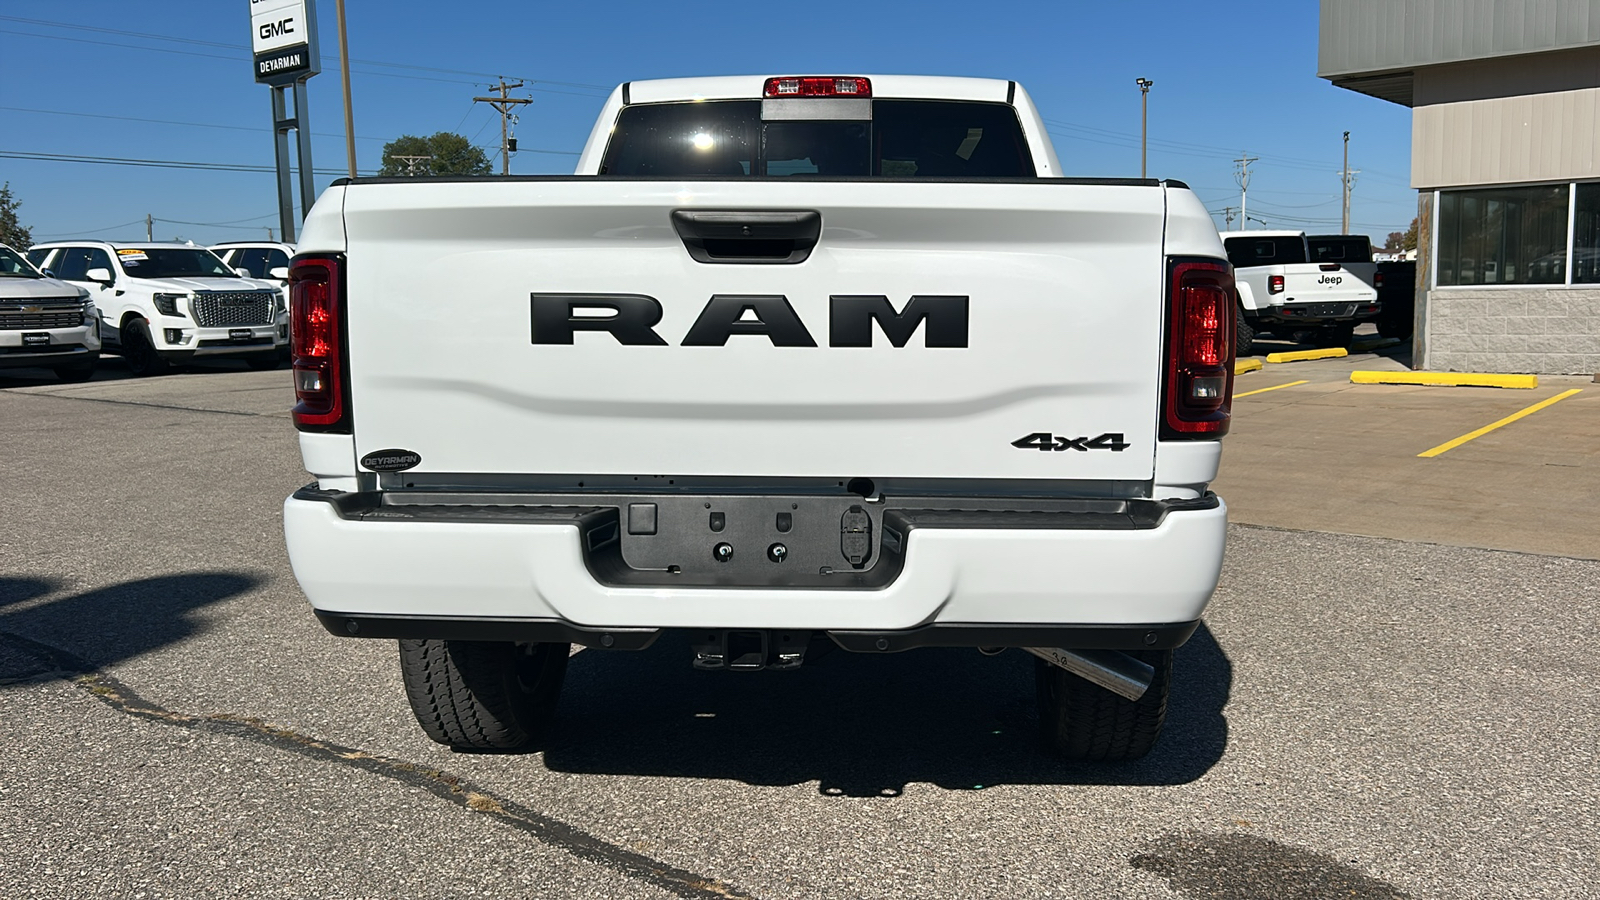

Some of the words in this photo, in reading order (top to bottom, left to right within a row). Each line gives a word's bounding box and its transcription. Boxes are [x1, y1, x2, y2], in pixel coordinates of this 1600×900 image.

[260, 18, 294, 39] GMC
[260, 54, 300, 73] DEYARMAN
[1318, 275, 1342, 285] Jeep
[530, 292, 969, 348] RAM
[1010, 432, 1131, 451] 4x4
[364, 455, 417, 466] DEYARMAN
